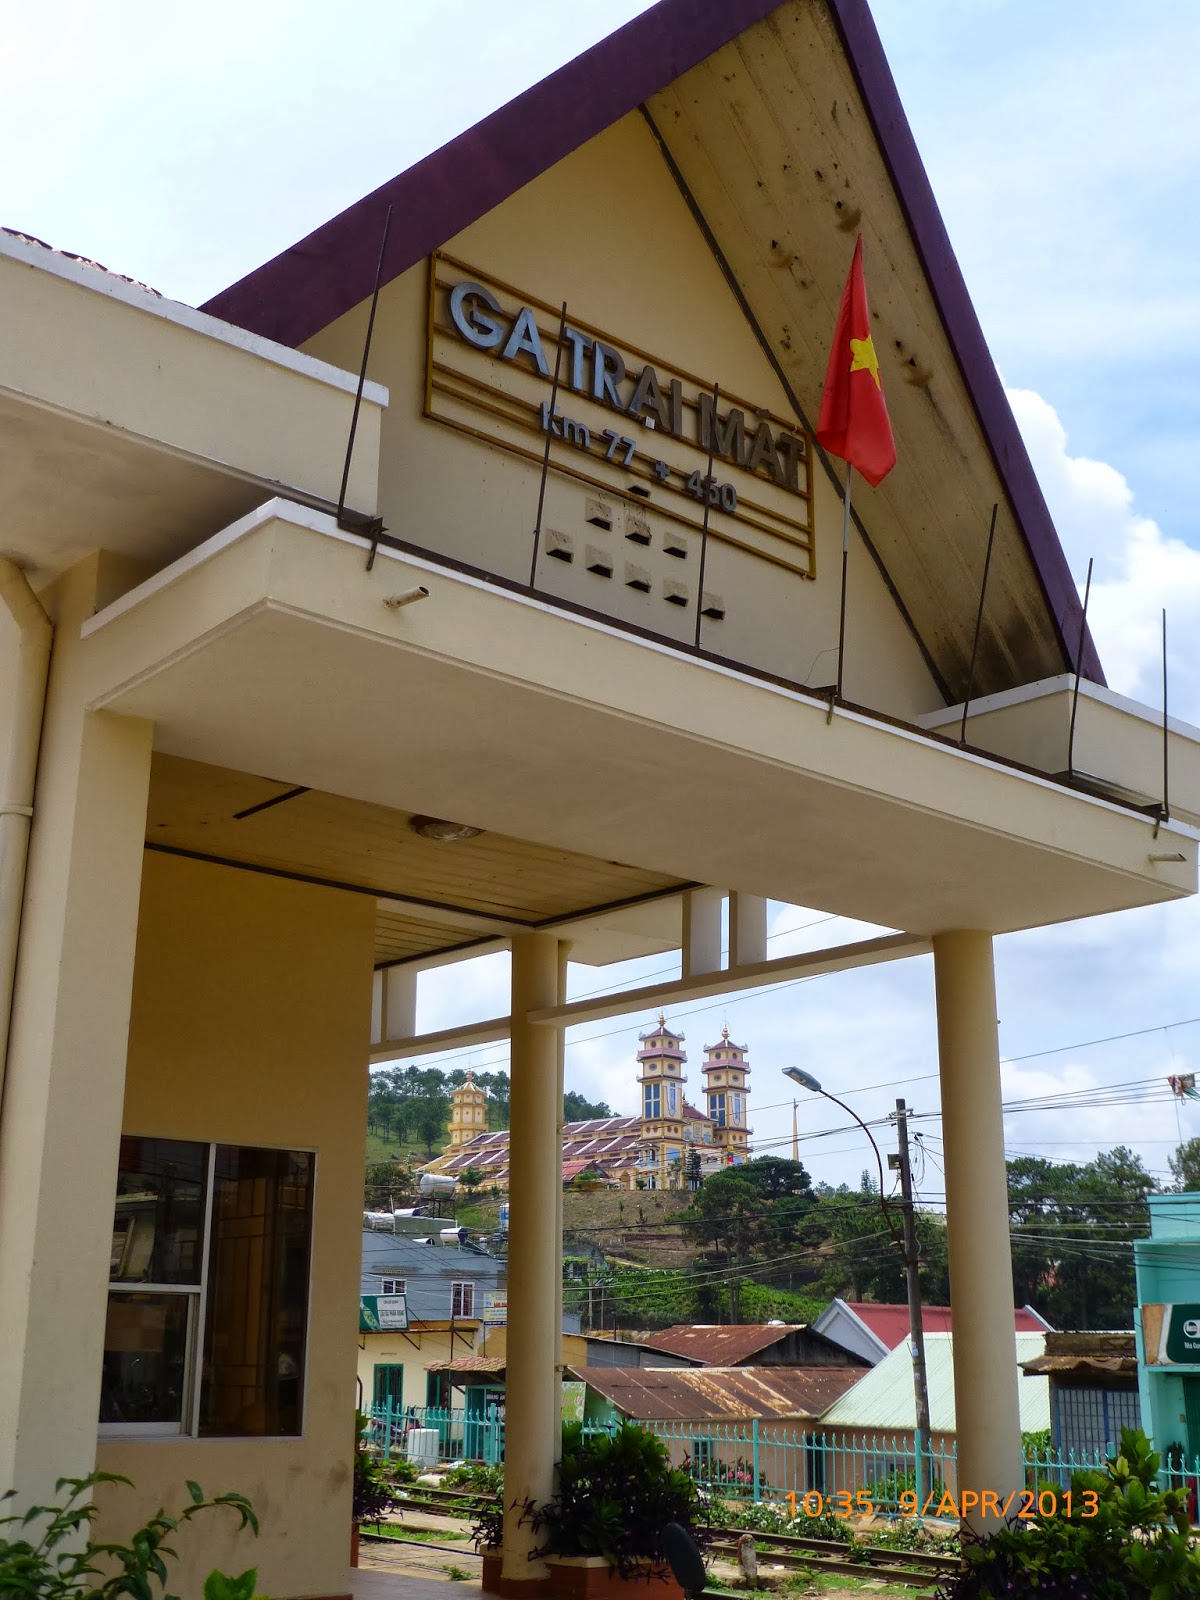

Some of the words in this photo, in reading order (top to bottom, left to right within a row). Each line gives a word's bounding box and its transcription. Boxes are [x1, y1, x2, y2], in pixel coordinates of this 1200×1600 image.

[450, 281, 550, 377] GA
[603, 428, 637, 466] 77
[656, 460, 671, 481] +
[687, 469, 737, 512] 450
